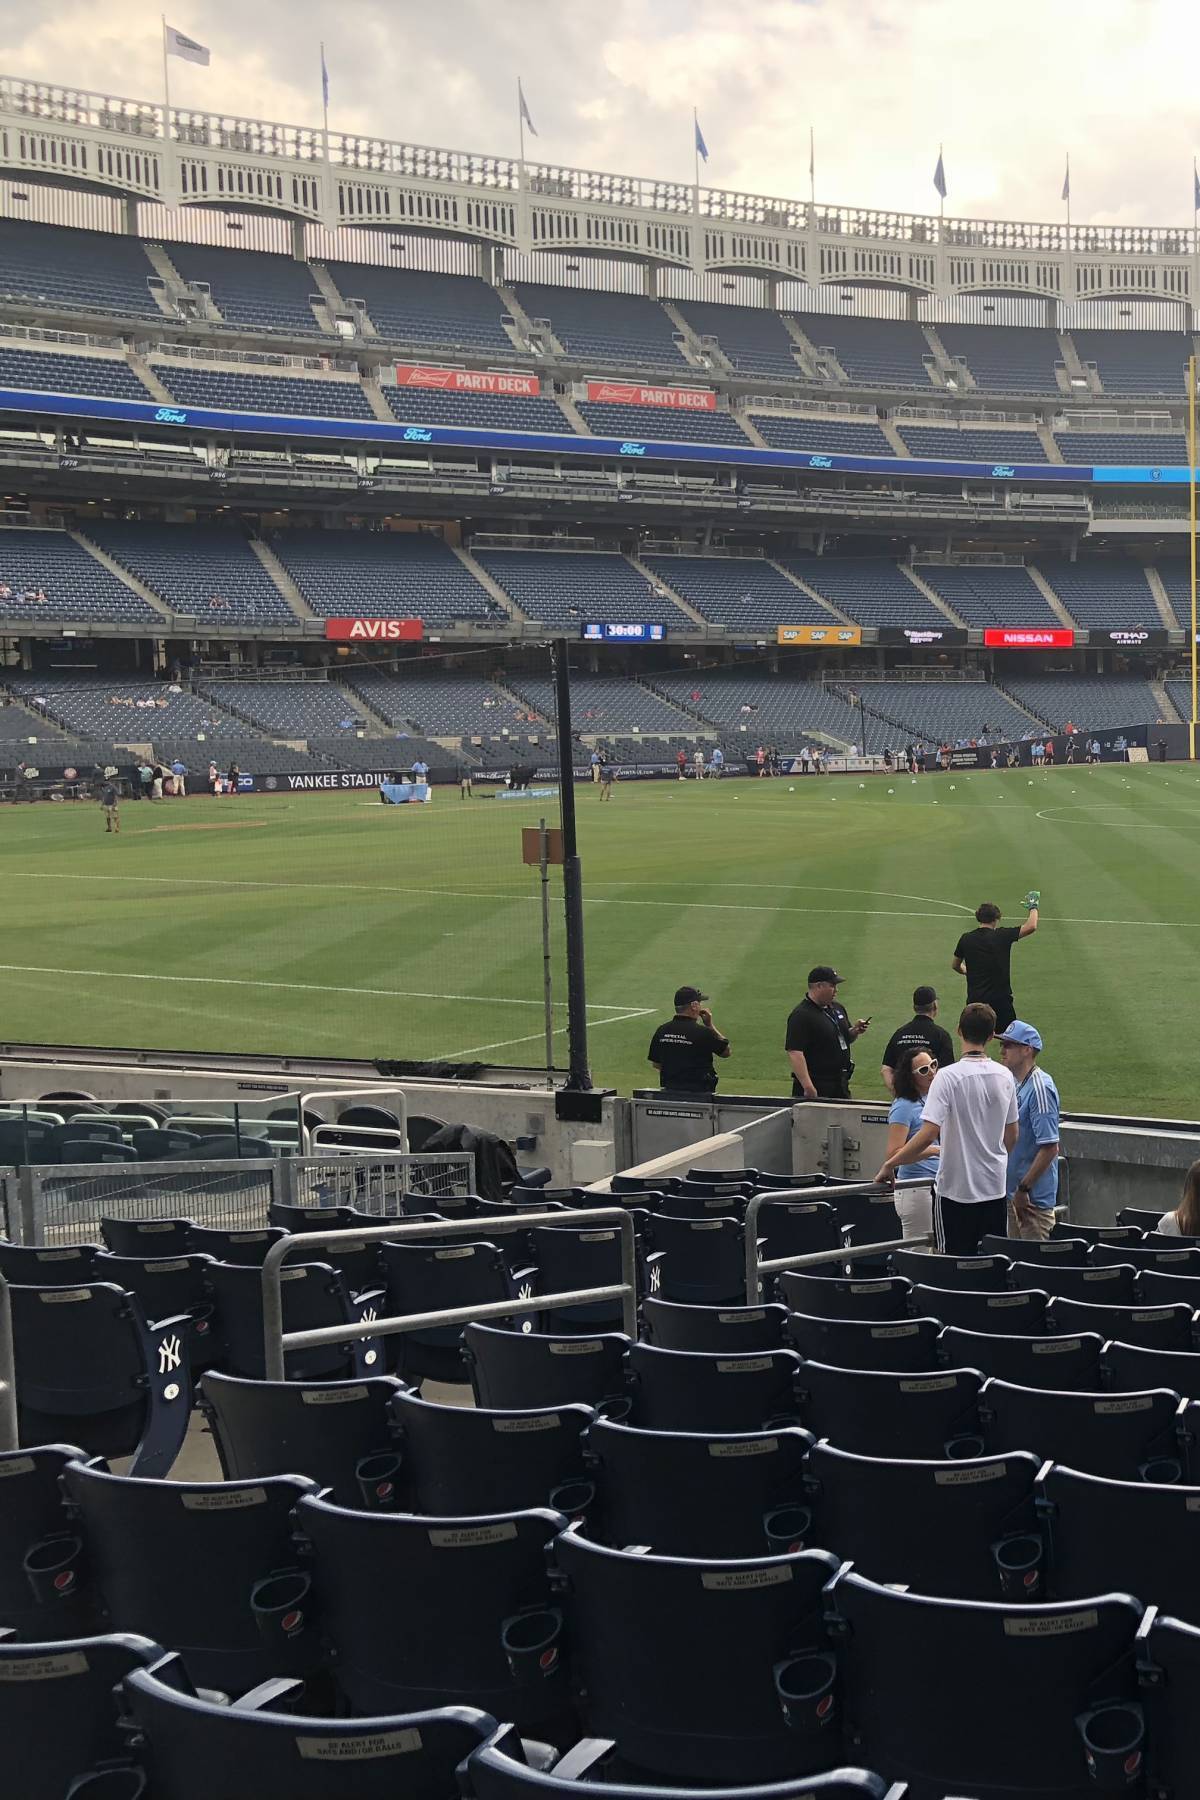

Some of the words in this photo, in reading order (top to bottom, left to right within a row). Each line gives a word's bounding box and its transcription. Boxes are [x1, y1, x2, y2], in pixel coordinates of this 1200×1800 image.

[456, 374, 497, 390] PARTY
[499, 378, 531, 393] DECK
[640, 390, 676, 405] PARTY
[678, 394, 708, 407] DECK
[155, 408, 187, 424] Ford
[403, 427, 432, 442] Ford
[619, 442, 646, 455] Ford
[809, 455, 832, 468] Ford
[991, 466, 1015, 477] Ford
[350, 621, 401, 638] AVIS
[608, 625, 643, 636] 30:00
[784, 631, 798, 639] SAP
[811, 631, 825, 640] SAP
[838, 632, 852, 640] SAP
[1109, 631, 1149, 640] ETIHAD
[1003, 633, 1054, 643] NISSAN
[288, 774, 338, 788] YANKEE
